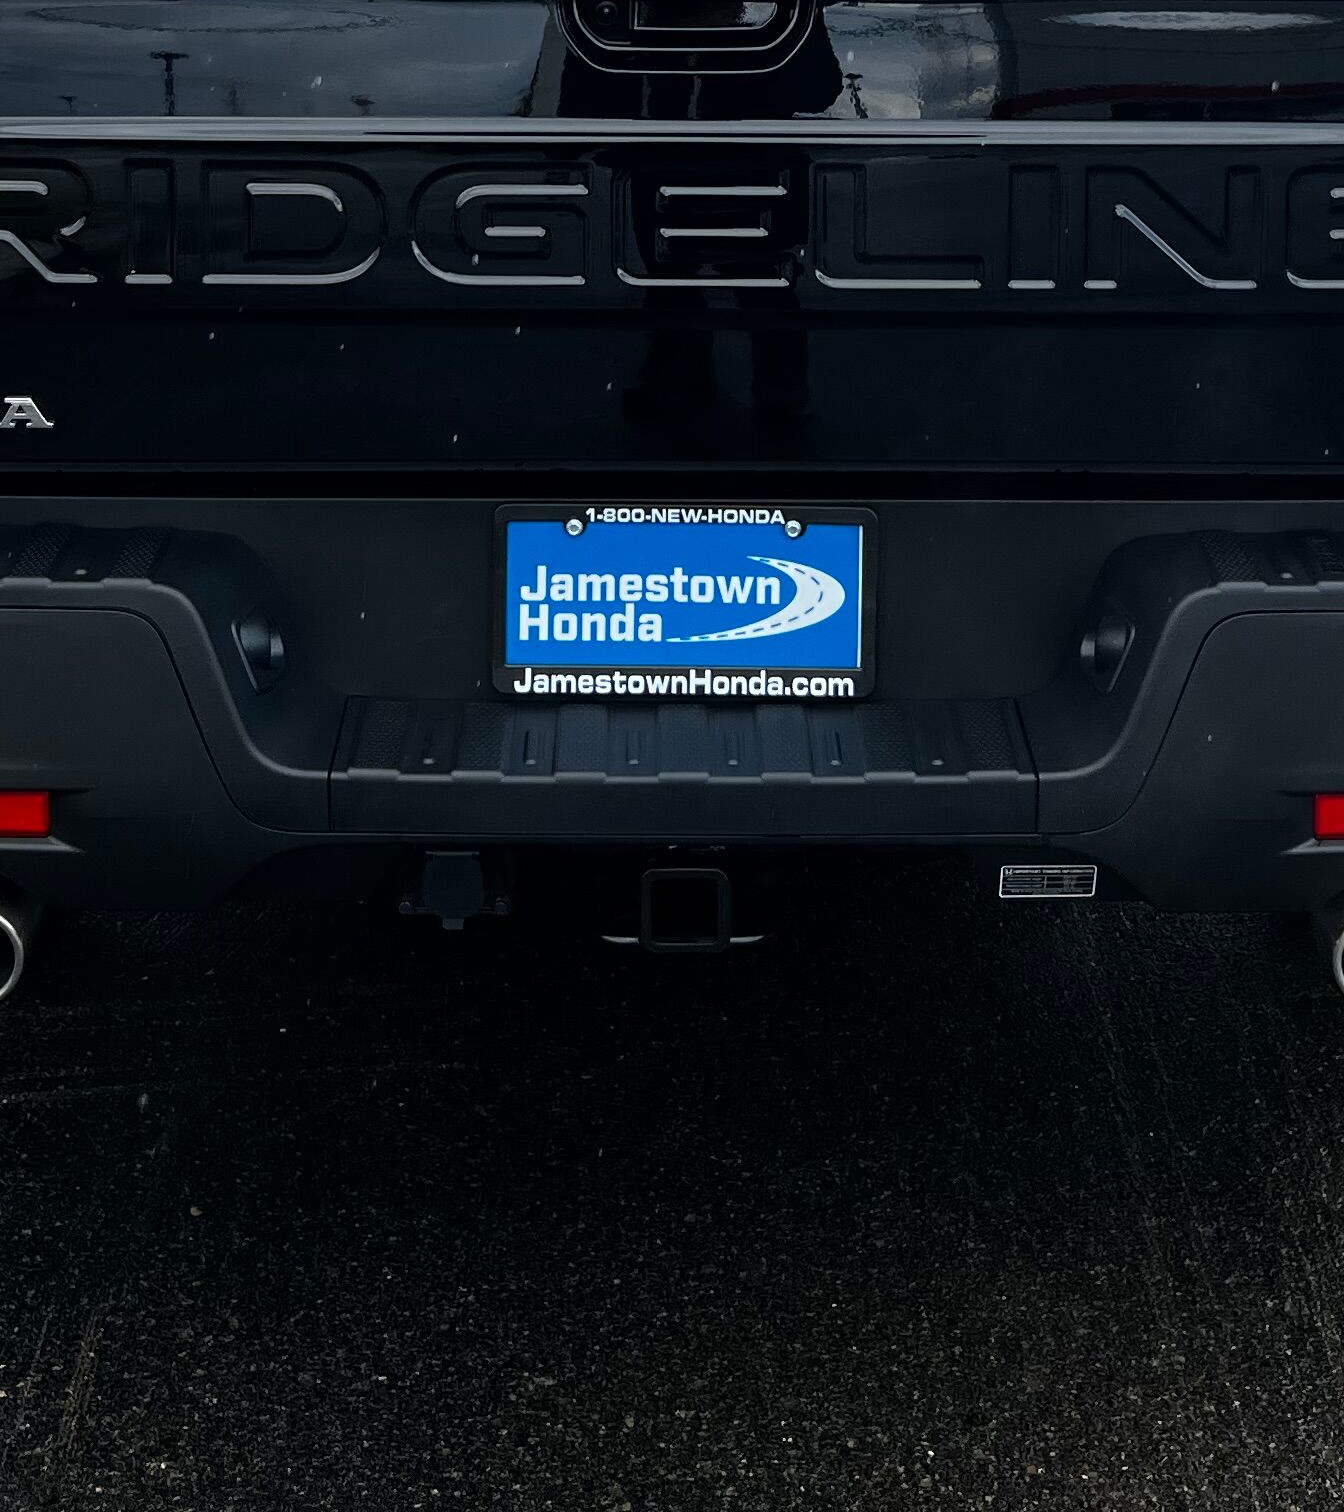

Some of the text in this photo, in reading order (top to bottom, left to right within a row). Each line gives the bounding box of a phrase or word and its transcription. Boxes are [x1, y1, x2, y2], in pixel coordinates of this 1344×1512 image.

[585, 508, 786, 525] 1-800-NEW-HONDA
[520, 565, 781, 605] Jamestown
[519, 603, 662, 642] Honda
[513, 667, 855, 697] JamestownHonda.com
